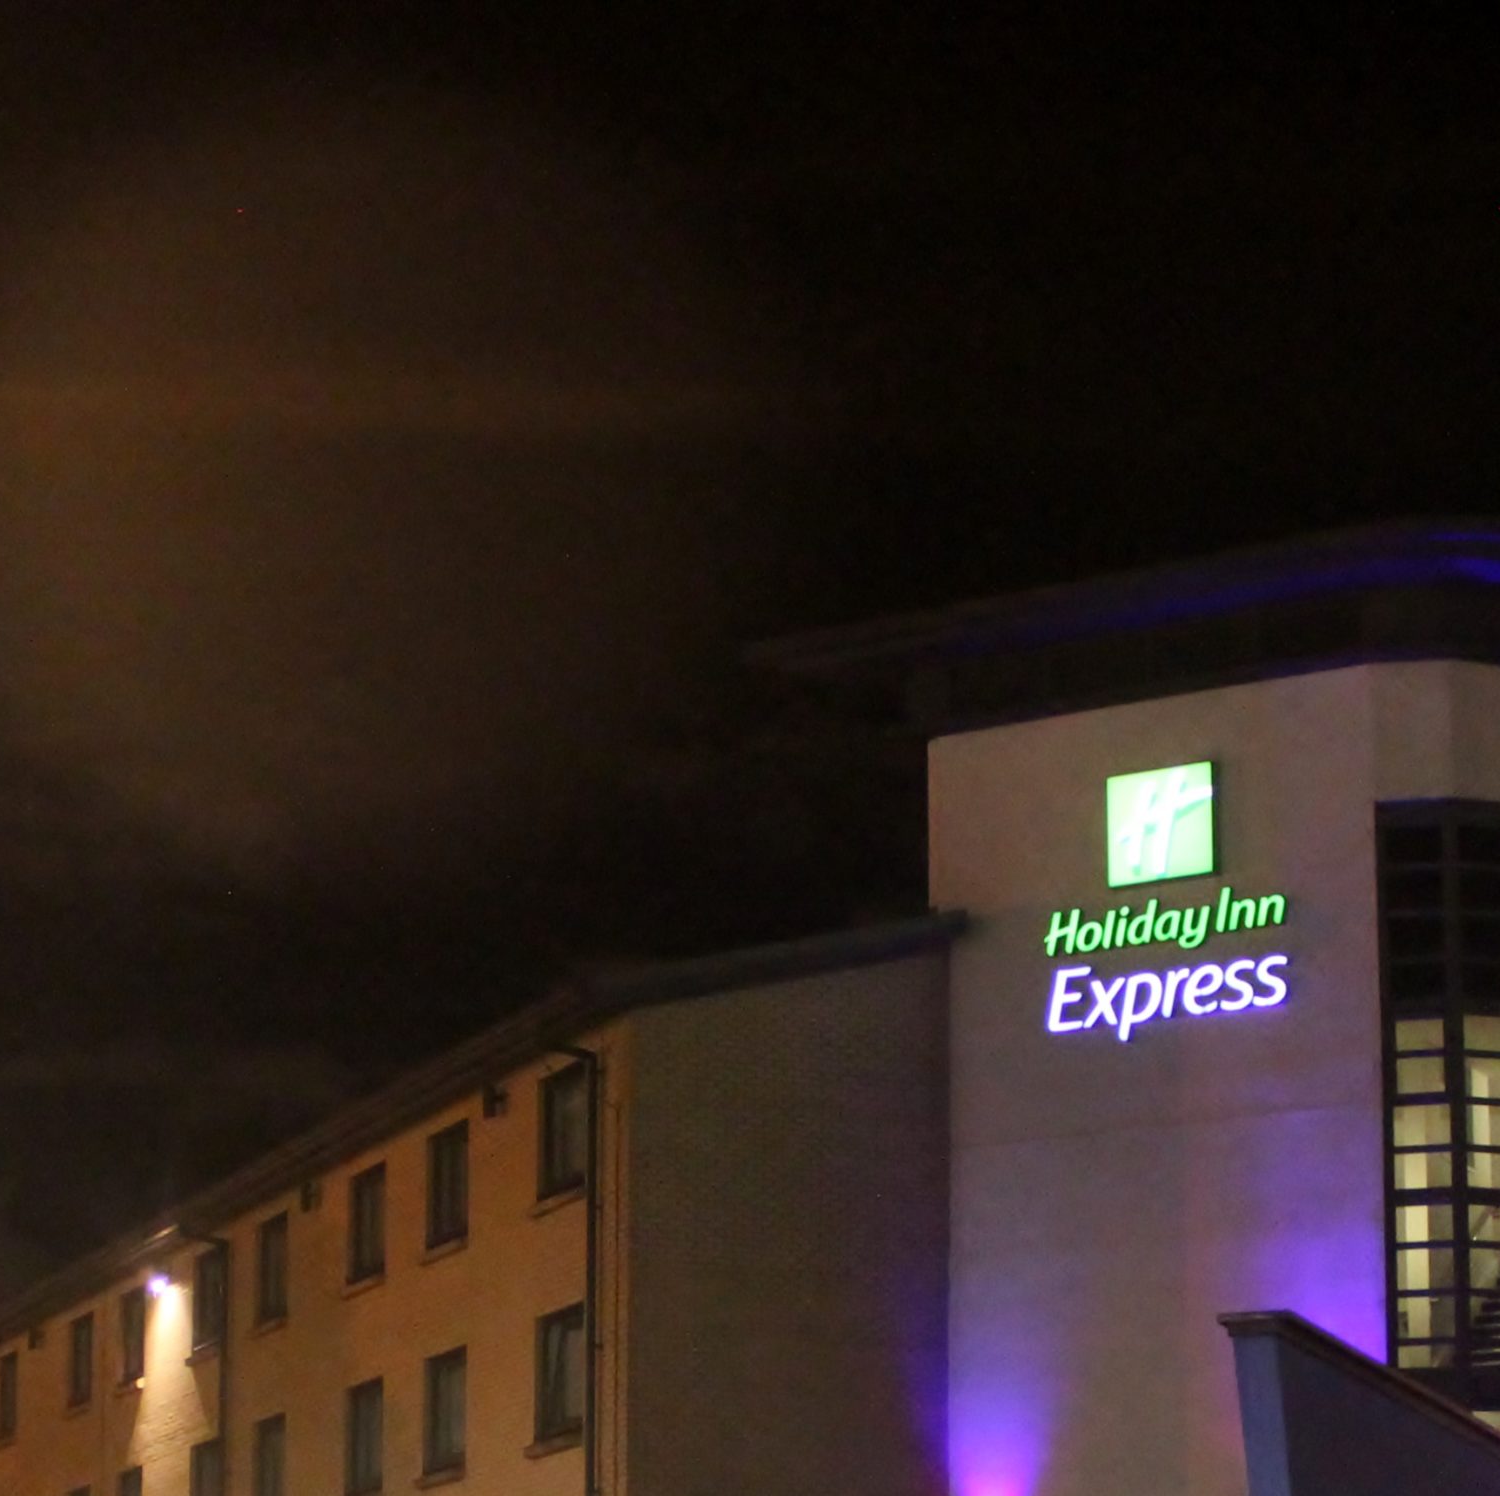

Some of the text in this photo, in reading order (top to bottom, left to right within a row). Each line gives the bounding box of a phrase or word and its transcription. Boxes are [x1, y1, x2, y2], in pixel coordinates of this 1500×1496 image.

[1043, 886, 1285, 957] Holiday Inn
[1047, 955, 1288, 1042] Express
